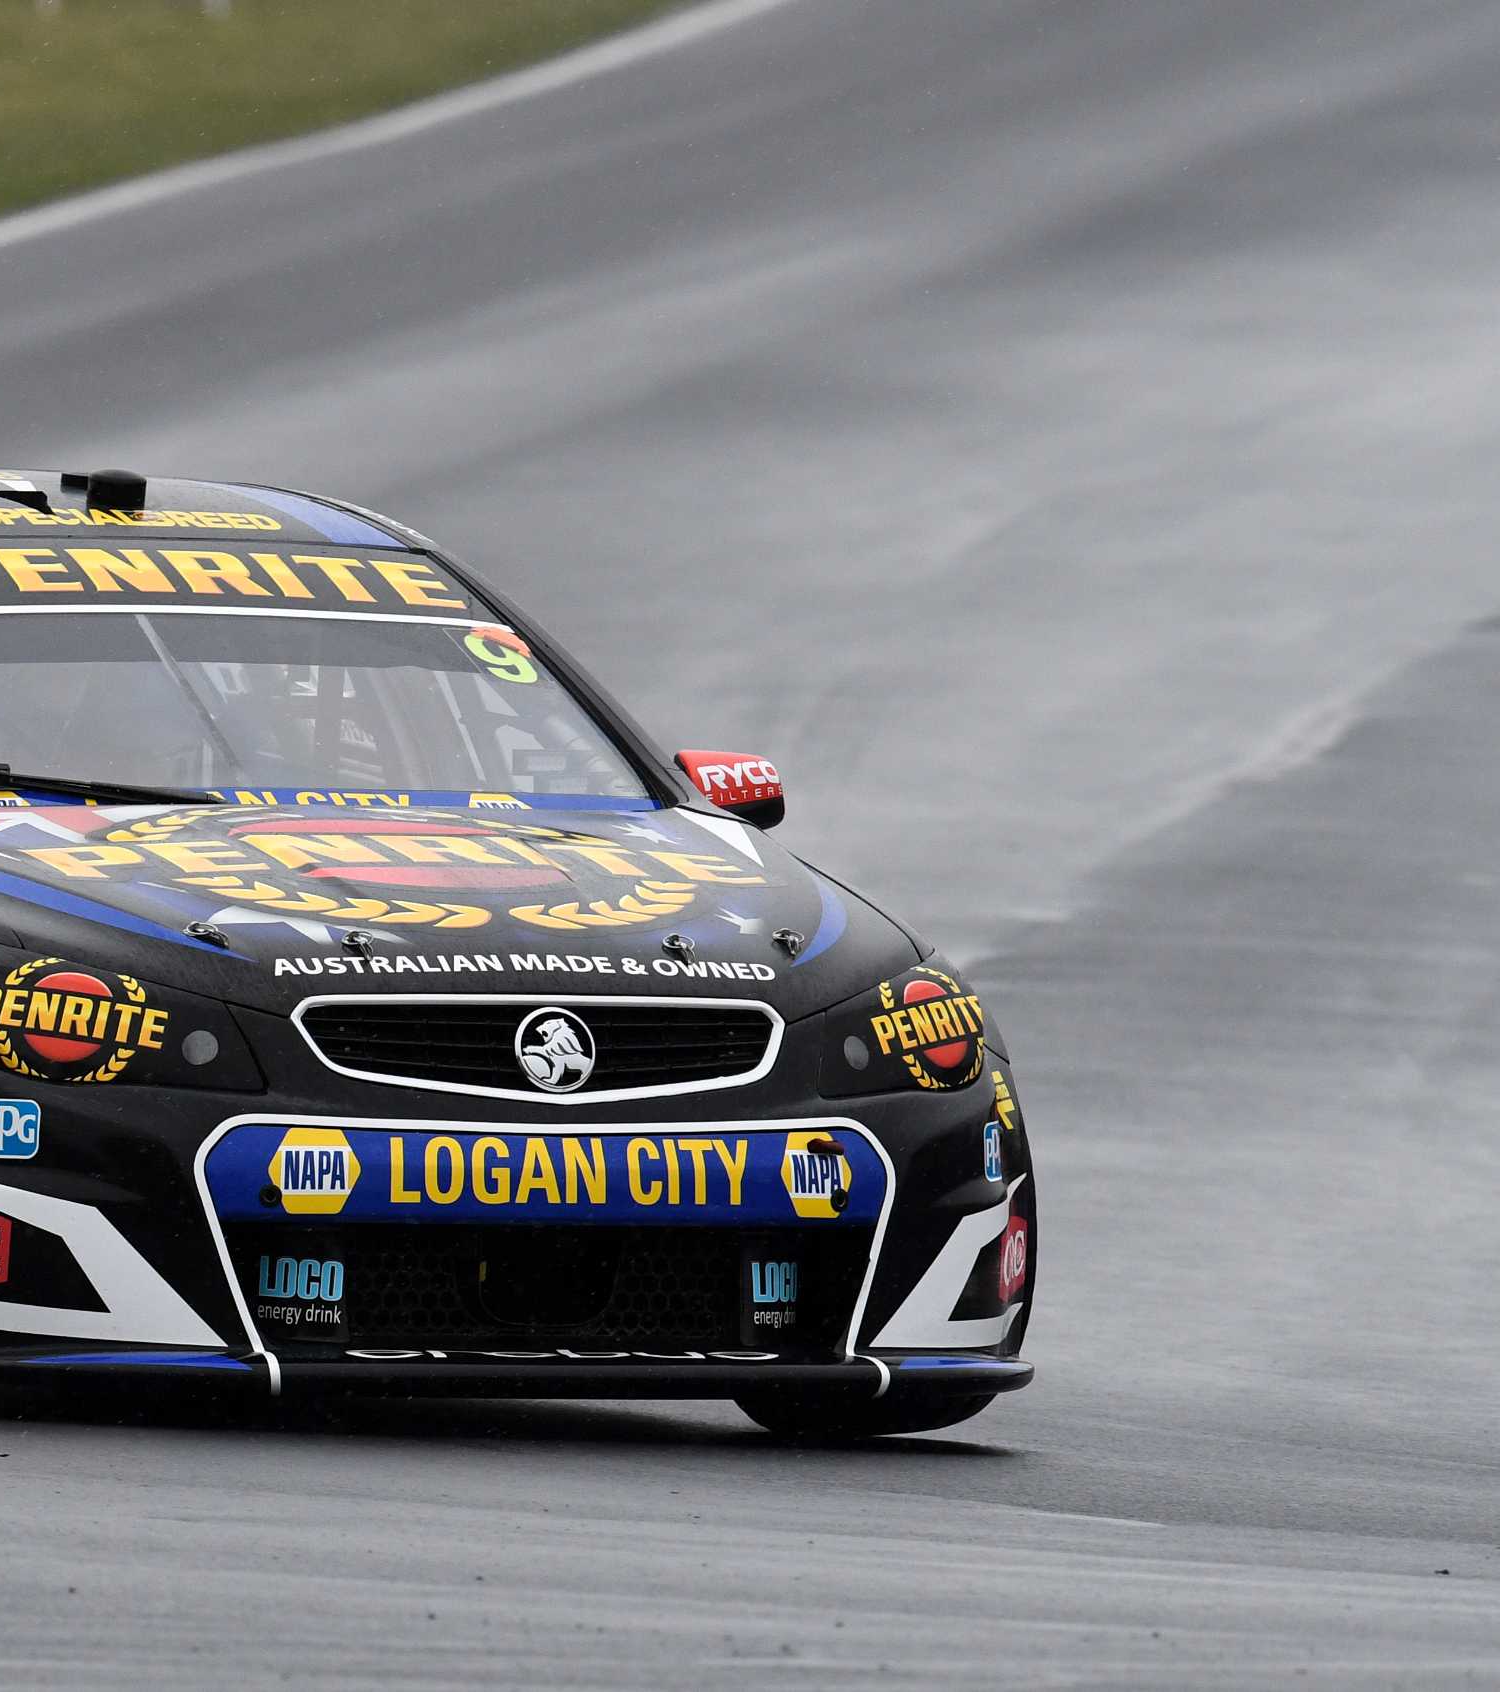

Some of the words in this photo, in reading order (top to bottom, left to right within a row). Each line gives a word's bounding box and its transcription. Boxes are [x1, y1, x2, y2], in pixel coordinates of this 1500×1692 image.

[463, 628, 539, 684] 9
[696, 760, 781, 791] RYCO
[16, 833, 765, 887] PENRITE
[274, 953, 501, 980] AUSTRALIAN
[511, 953, 612, 976] MADE
[621, 954, 647, 976] &
[653, 957, 776, 983] OWNED
[283, 1150, 347, 1192] NAPA
[391, 1136, 607, 1206] LOGAN
[627, 1137, 750, 1206] CITY
[986, 1129, 1002, 1175] PP
[791, 1153, 843, 1195] NAPA
[258, 1256, 344, 1300] LOCO
[257, 1304, 302, 1326] energy
[305, 1302, 343, 1325] drink
[754, 1311, 783, 1329] energy
